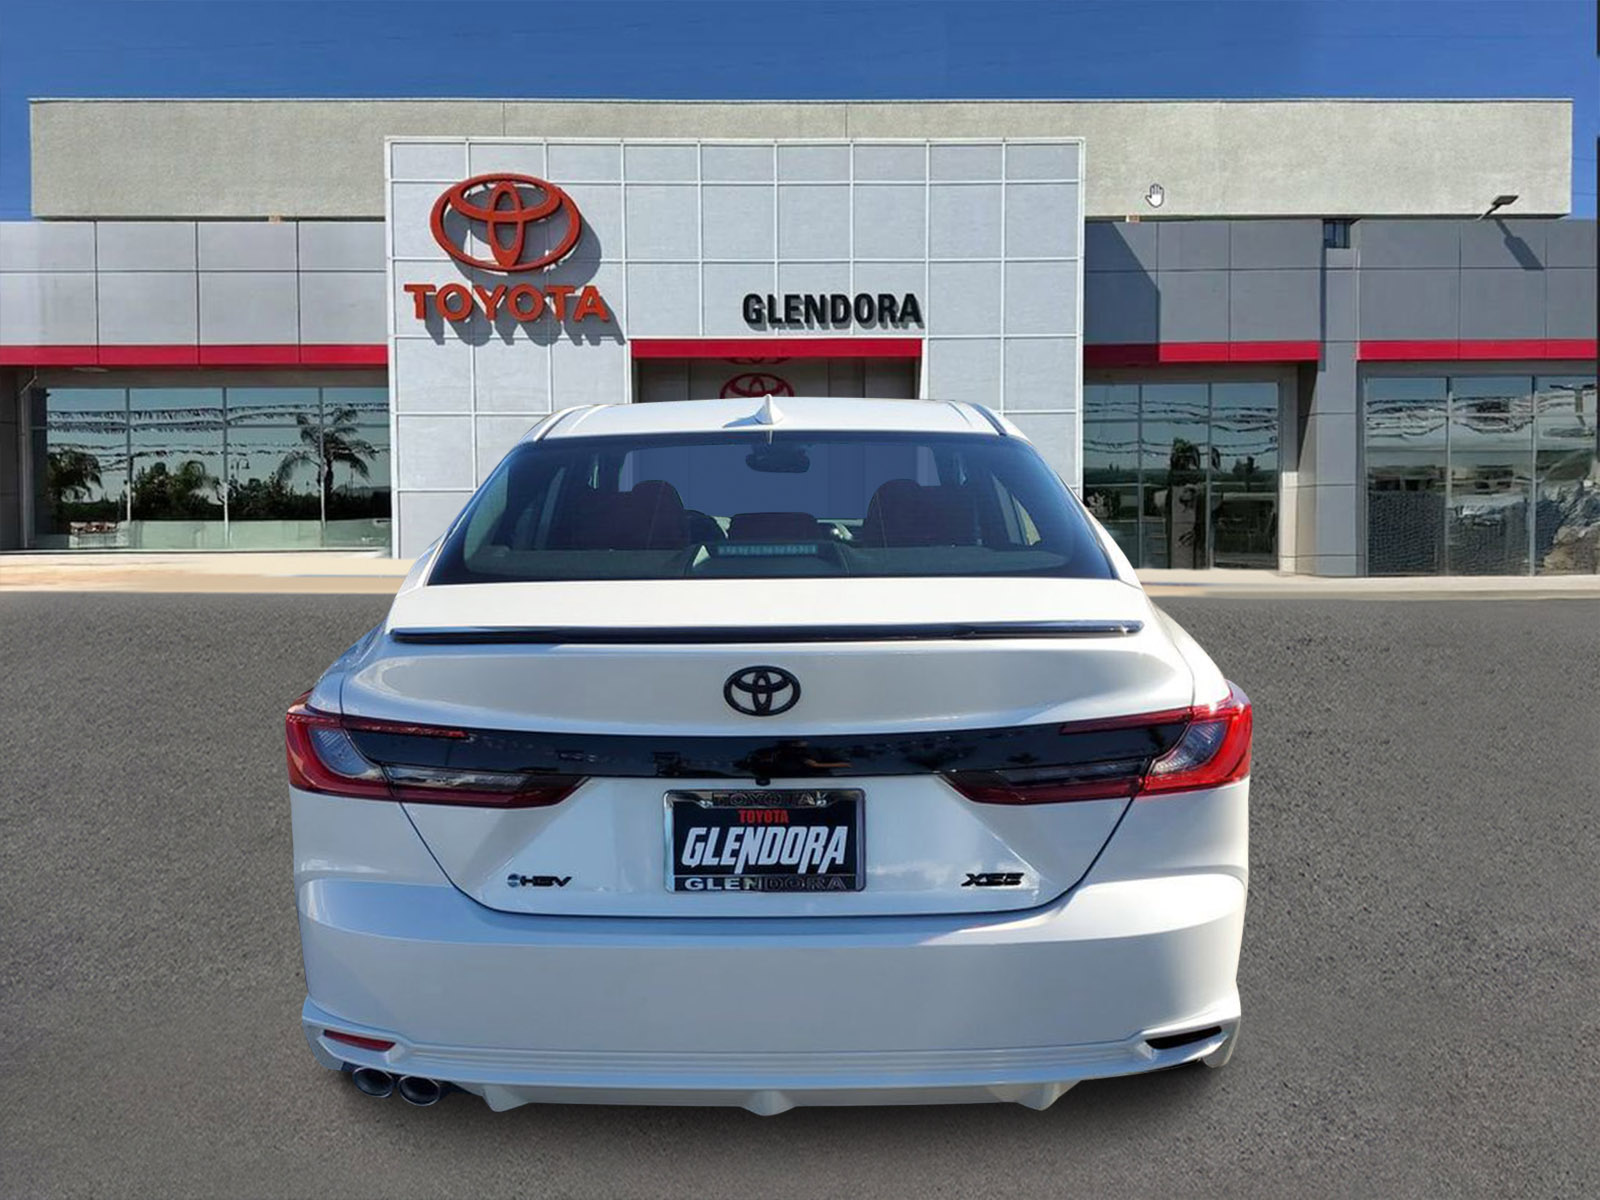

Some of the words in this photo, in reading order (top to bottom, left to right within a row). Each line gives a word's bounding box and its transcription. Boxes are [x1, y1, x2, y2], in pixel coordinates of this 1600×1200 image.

[404, 284, 609, 322] TOYOTA
[742, 293, 922, 325] GLENDORA
[738, 809, 789, 823] TOYOTA
[681, 826, 848, 874] GLENDORA
[684, 877, 847, 890] GLENDORA
